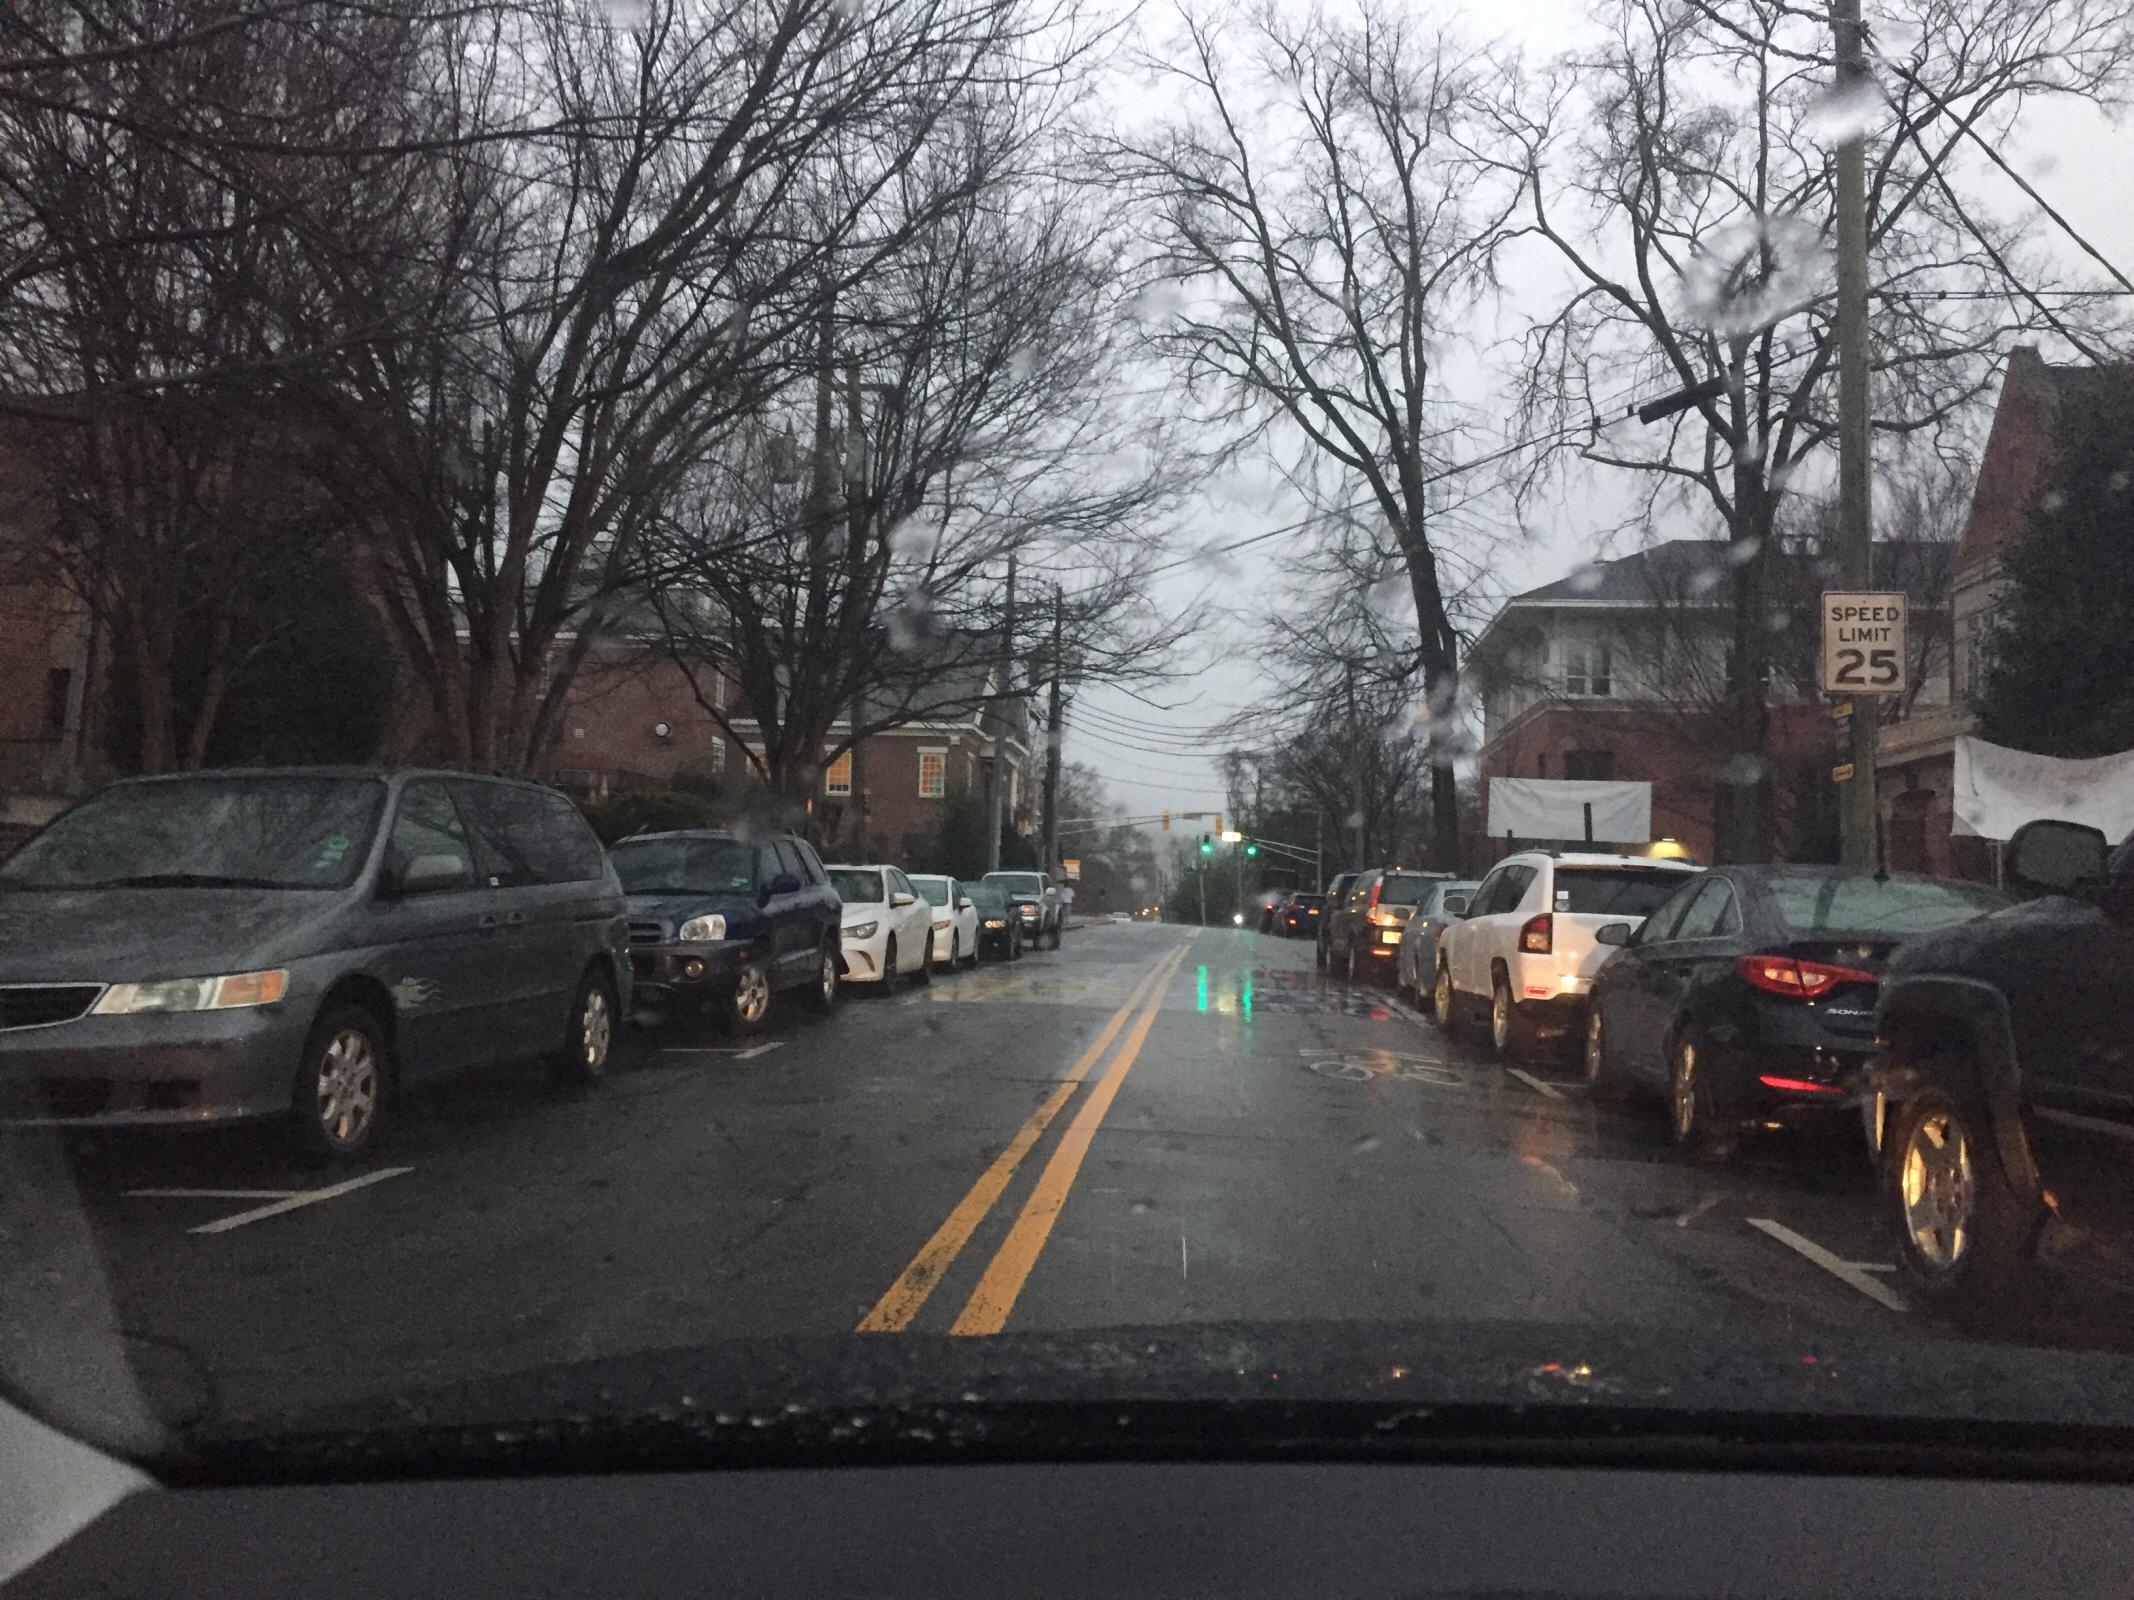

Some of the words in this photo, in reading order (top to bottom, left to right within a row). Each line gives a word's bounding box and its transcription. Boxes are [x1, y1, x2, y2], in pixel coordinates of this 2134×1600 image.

[1831, 606, 1899, 622] SPEED
[1838, 627, 1892, 642] LIMIT
[1835, 648, 1899, 685] 25
